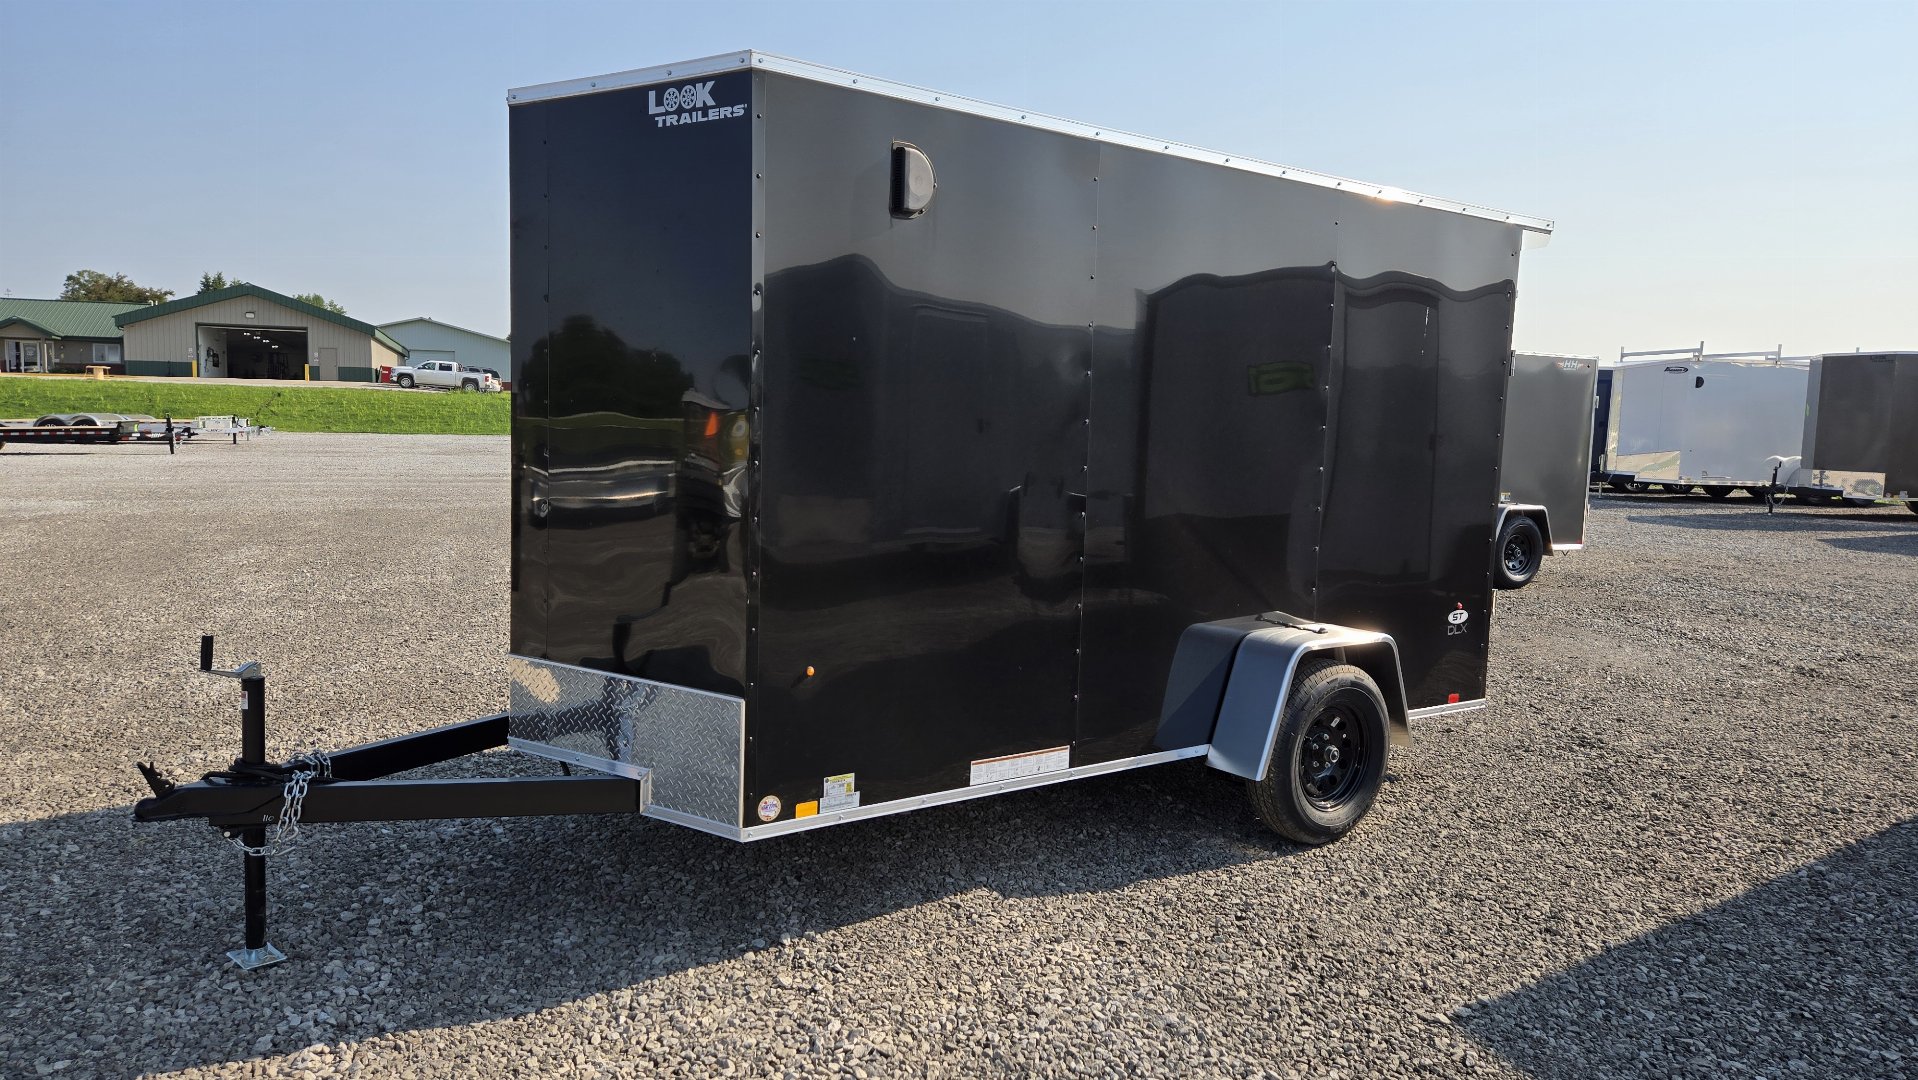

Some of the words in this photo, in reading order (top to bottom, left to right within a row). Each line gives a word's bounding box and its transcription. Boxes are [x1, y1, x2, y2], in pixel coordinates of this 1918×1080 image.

[648, 81, 716, 115] LOOK
[655, 104, 745, 128] TRAILERS
[1563, 360, 1578, 368] HH
[1452, 612, 1464, 621] ST
[1447, 623, 1468, 636] DLX
